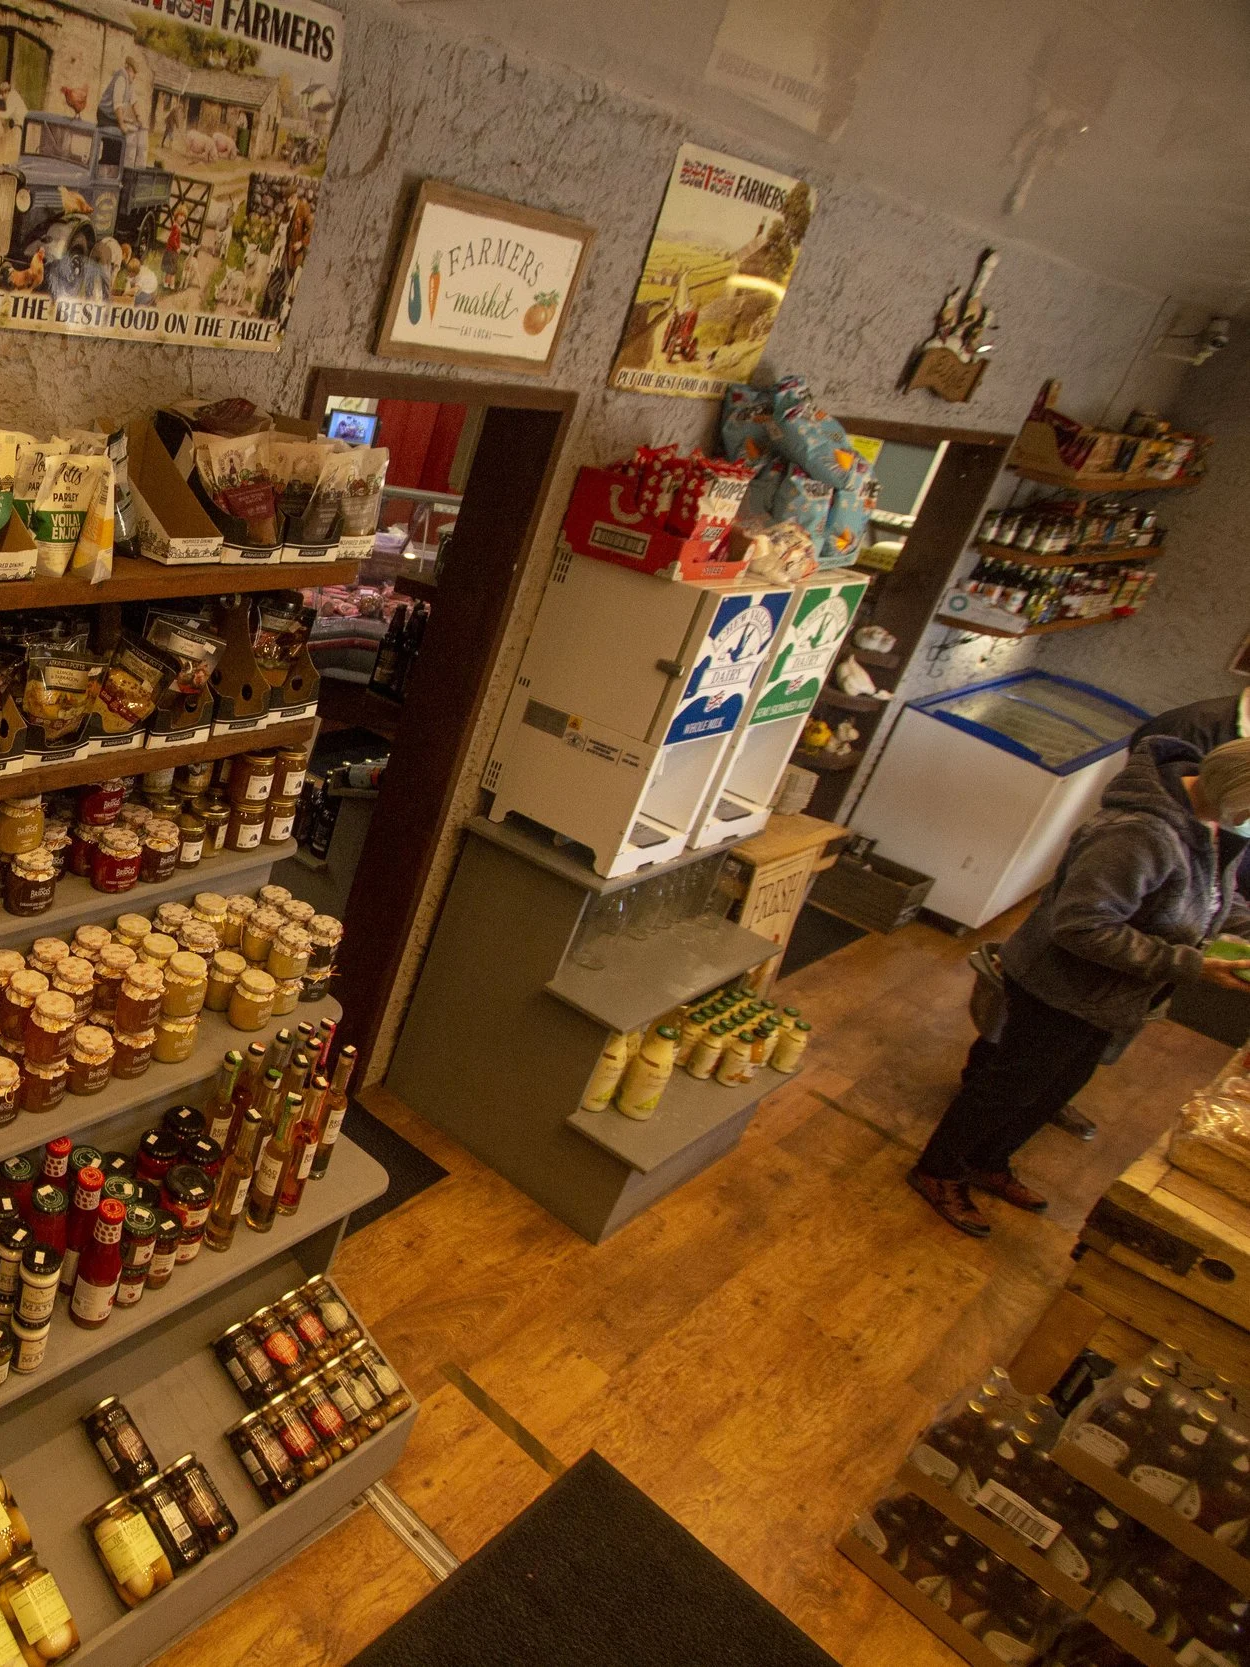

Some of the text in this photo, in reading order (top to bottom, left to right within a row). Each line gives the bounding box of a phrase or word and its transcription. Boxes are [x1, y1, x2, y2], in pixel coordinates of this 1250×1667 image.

[220, 0, 335, 62] FARMERS
[733, 175, 787, 212] FARMERS
[447, 237, 545, 288] FARMERS
[10, 295, 50, 323] THE
[55, 301, 105, 327] BEST
[108, 306, 159, 332] FOOD
[163, 314, 190, 336] ON
[193, 317, 226, 339] THE
[228, 320, 276, 343] TABLE
[446, 282, 519, 320] market
[617, 370, 636, 385] PUT
[637, 372, 654, 387] THE
[655, 373, 676, 389] BEST
[709, 482, 747, 500] PROPE
[710, 670, 742, 684] DAIRY
[793, 654, 820, 666] DAIRY
